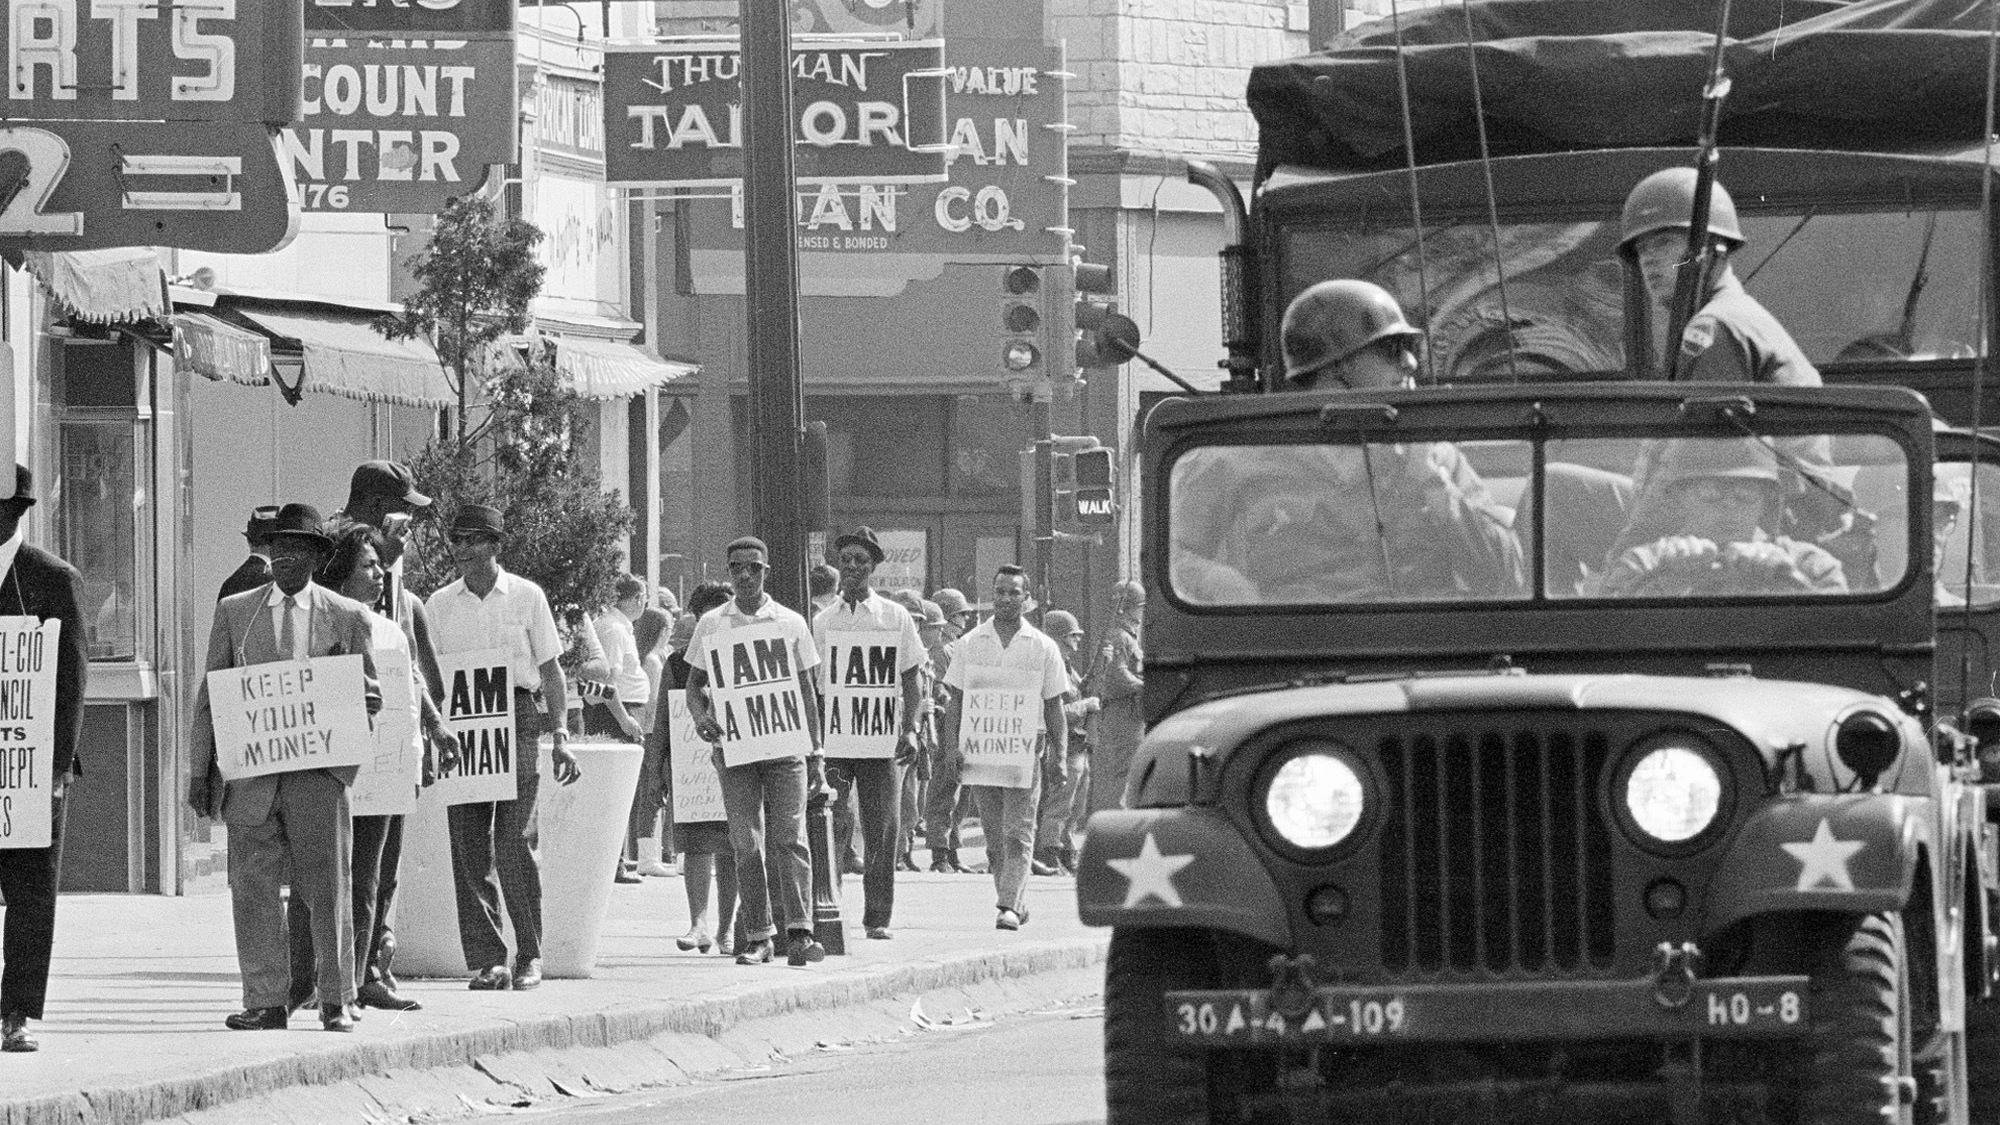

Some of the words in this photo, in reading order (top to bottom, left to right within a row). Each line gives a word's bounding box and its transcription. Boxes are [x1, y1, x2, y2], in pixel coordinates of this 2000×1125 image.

[9, 0, 236, 101] RTS
[653, 54, 867, 94] THUMAN
[949, 67, 1038, 95] VALUE
[628, 101, 906, 149] TAIOR
[935, 185, 1025, 232] CO.
[833, 236, 842, 249] &
[845, 236, 888, 249] BONDED
[1078, 500, 1111, 515] WALK
[884, 549, 922, 563] OVED
[0, 631, 43, 673] L-CIO
[710, 649, 725, 689] I
[733, 637, 791, 685] AM
[831, 646, 838, 685] I
[845, 645, 897, 685] AM
[241, 668, 314, 701] KEEP
[450, 666, 508, 716] AM
[970, 693, 1025, 711] KEEP
[246, 702, 316, 733] YOUR
[725, 700, 741, 742] A
[745, 690, 801, 737] MAN
[830, 696, 841, 734] A
[852, 696, 895, 736] MAN
[969, 716, 1023, 734] YOUR
[245, 729, 332, 767] MONEY
[457, 727, 509, 777] MAN
[965, 737, 1032, 754] MONEY
